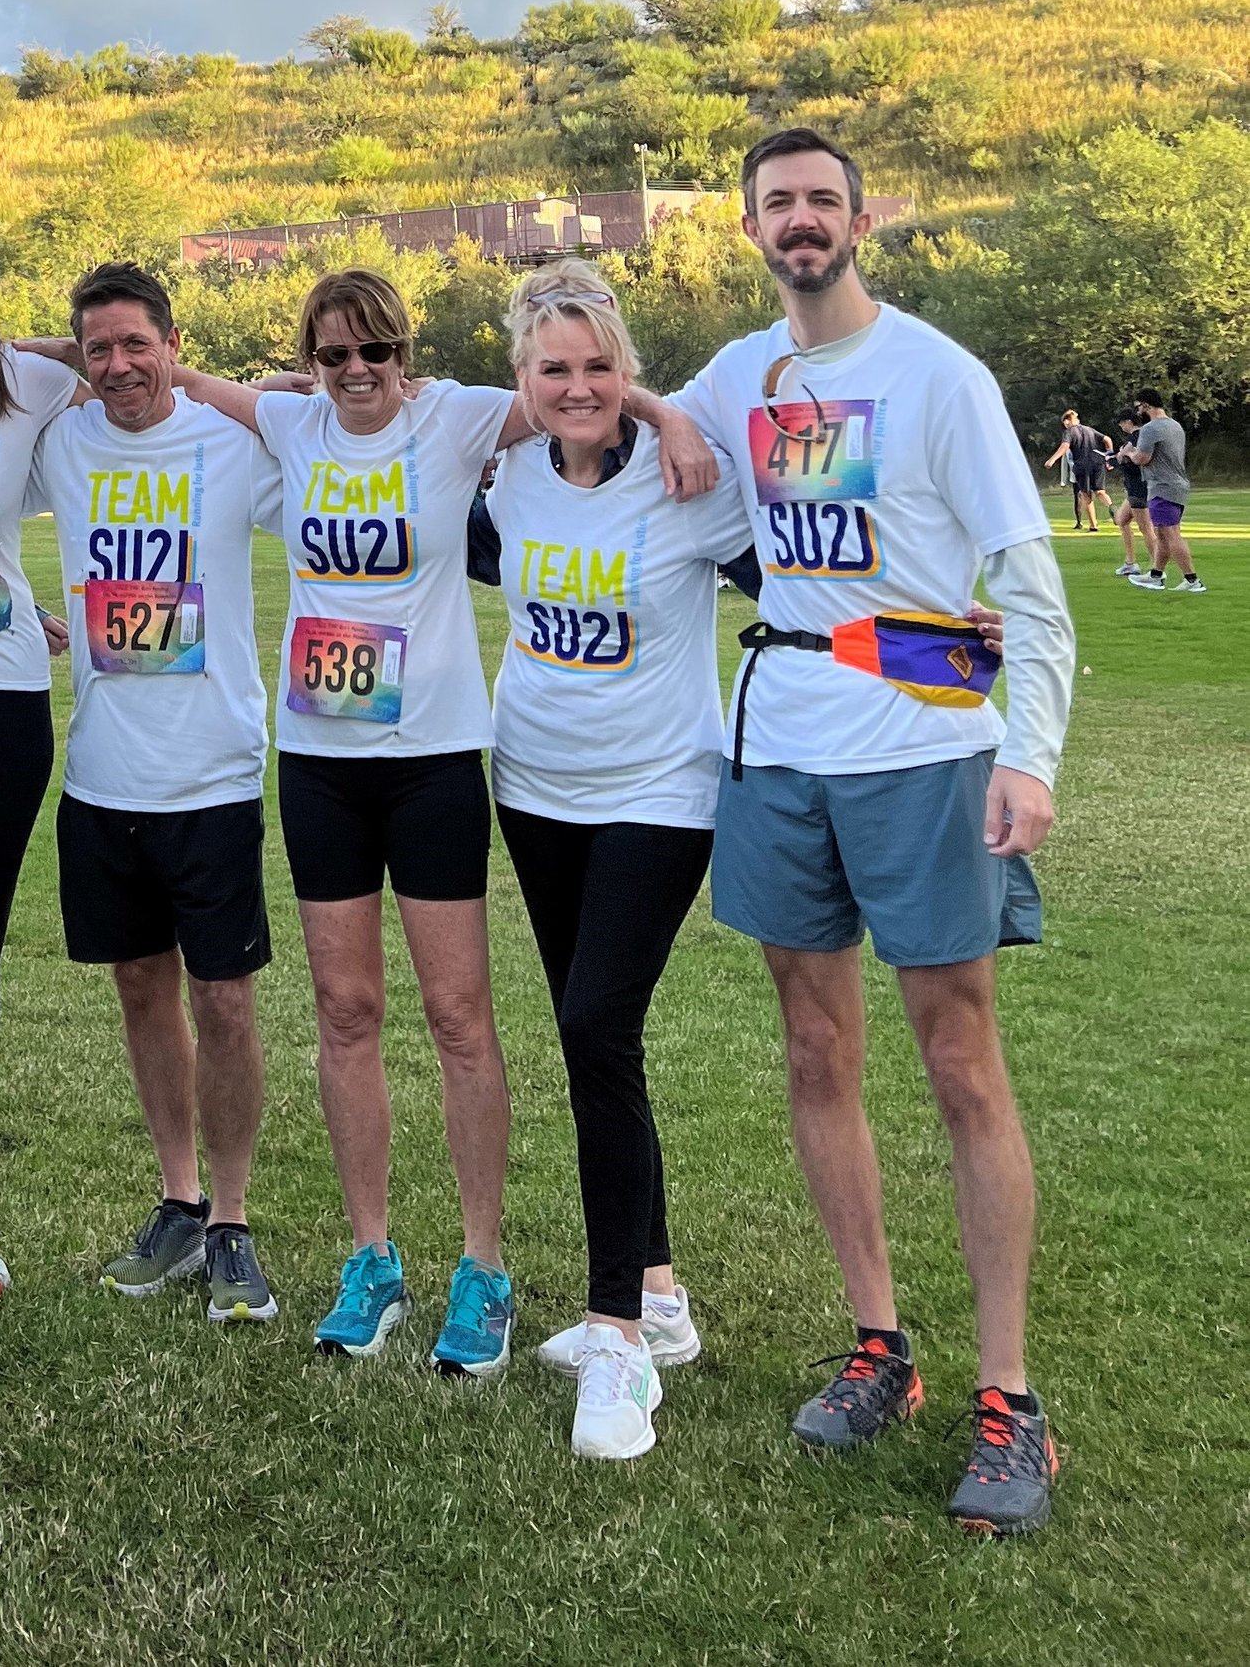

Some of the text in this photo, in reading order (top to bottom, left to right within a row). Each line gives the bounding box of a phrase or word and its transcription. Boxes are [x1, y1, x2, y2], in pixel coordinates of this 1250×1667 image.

[406, 459, 416, 473] for
[768, 421, 842, 477] 417
[88, 470, 190, 524] TEAM
[193, 471, 203, 485] for
[302, 461, 406, 514] TEAM
[407, 474, 419, 514] Running
[192, 486, 205, 527] Running
[302, 517, 409, 576] SU2J
[629, 549, 642, 566] for
[769, 502, 874, 571] SU2J
[519, 538, 628, 607] TEAM
[106, 601, 177, 652] 527
[526, 601, 631, 665] SU2J
[304, 638, 377, 697] 538
